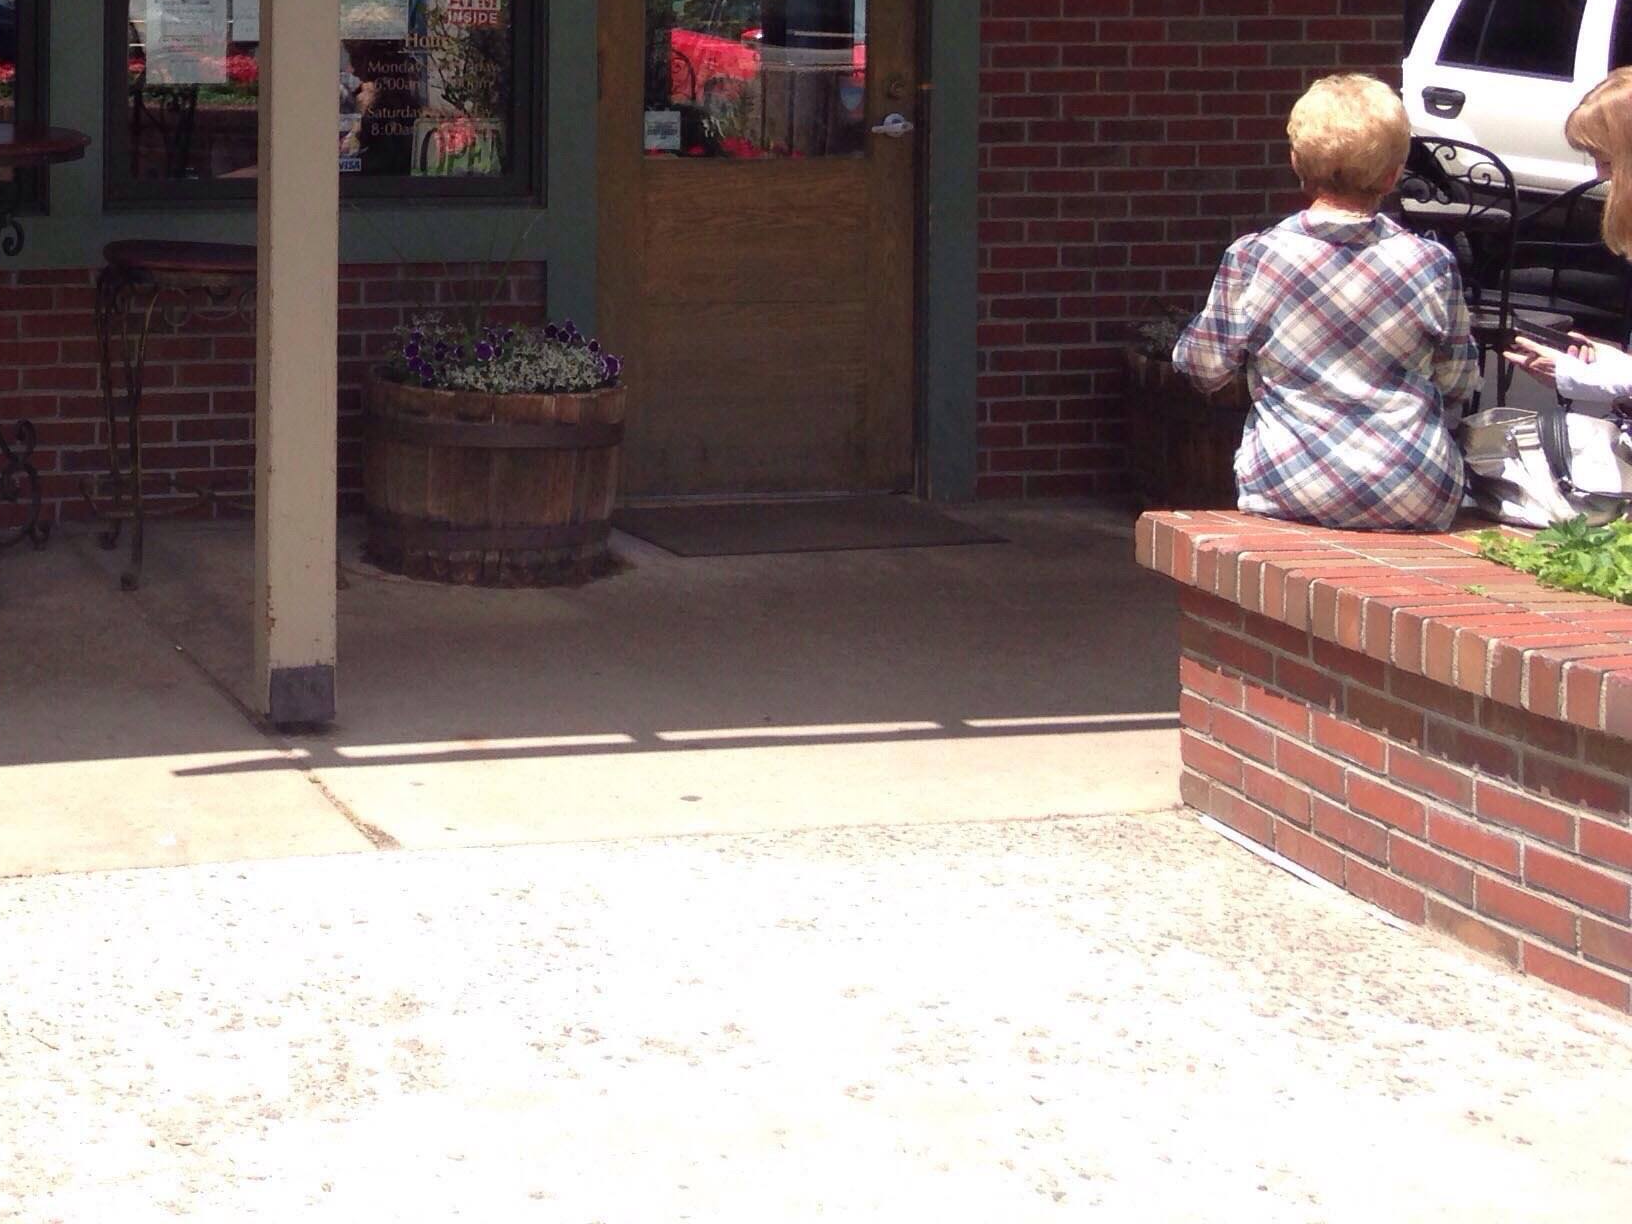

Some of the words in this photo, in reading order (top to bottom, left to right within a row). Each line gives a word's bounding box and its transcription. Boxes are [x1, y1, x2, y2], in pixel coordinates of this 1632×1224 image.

[447, 10, 498, 25] INSIDE
[404, 32, 452, 49] Hour
[367, 105, 423, 120] Saturda
